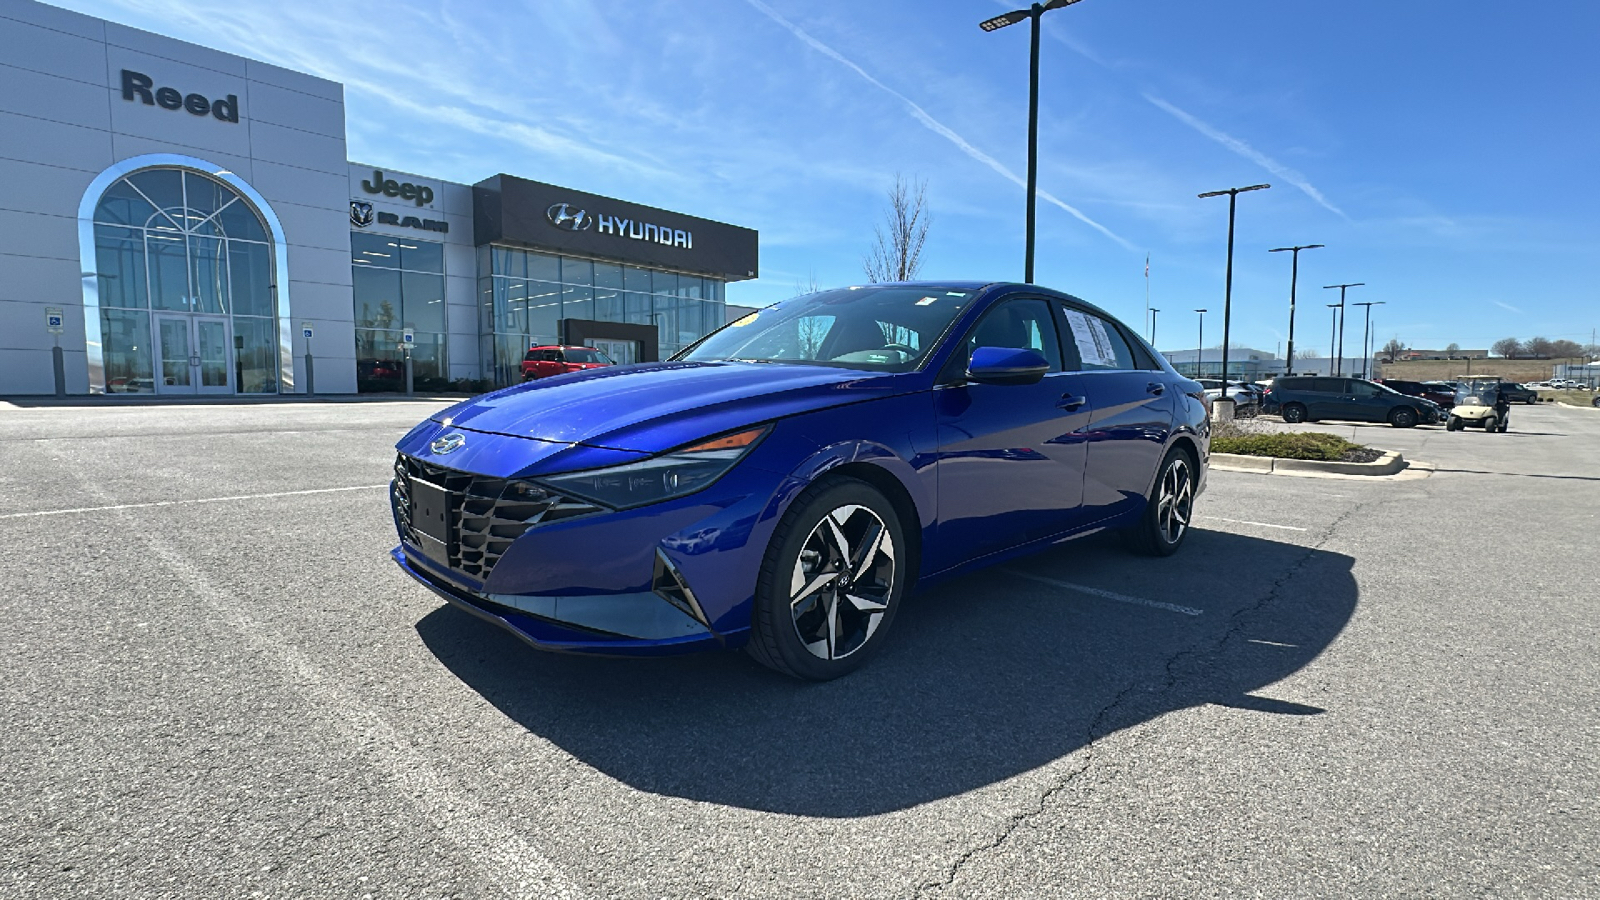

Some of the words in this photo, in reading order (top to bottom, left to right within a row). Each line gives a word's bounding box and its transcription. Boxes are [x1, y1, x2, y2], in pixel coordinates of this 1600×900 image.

[121, 69, 239, 123] Reed
[362, 170, 433, 207] Jeep
[377, 212, 449, 233] RAM
[598, 213, 693, 249] HYUNDAI
